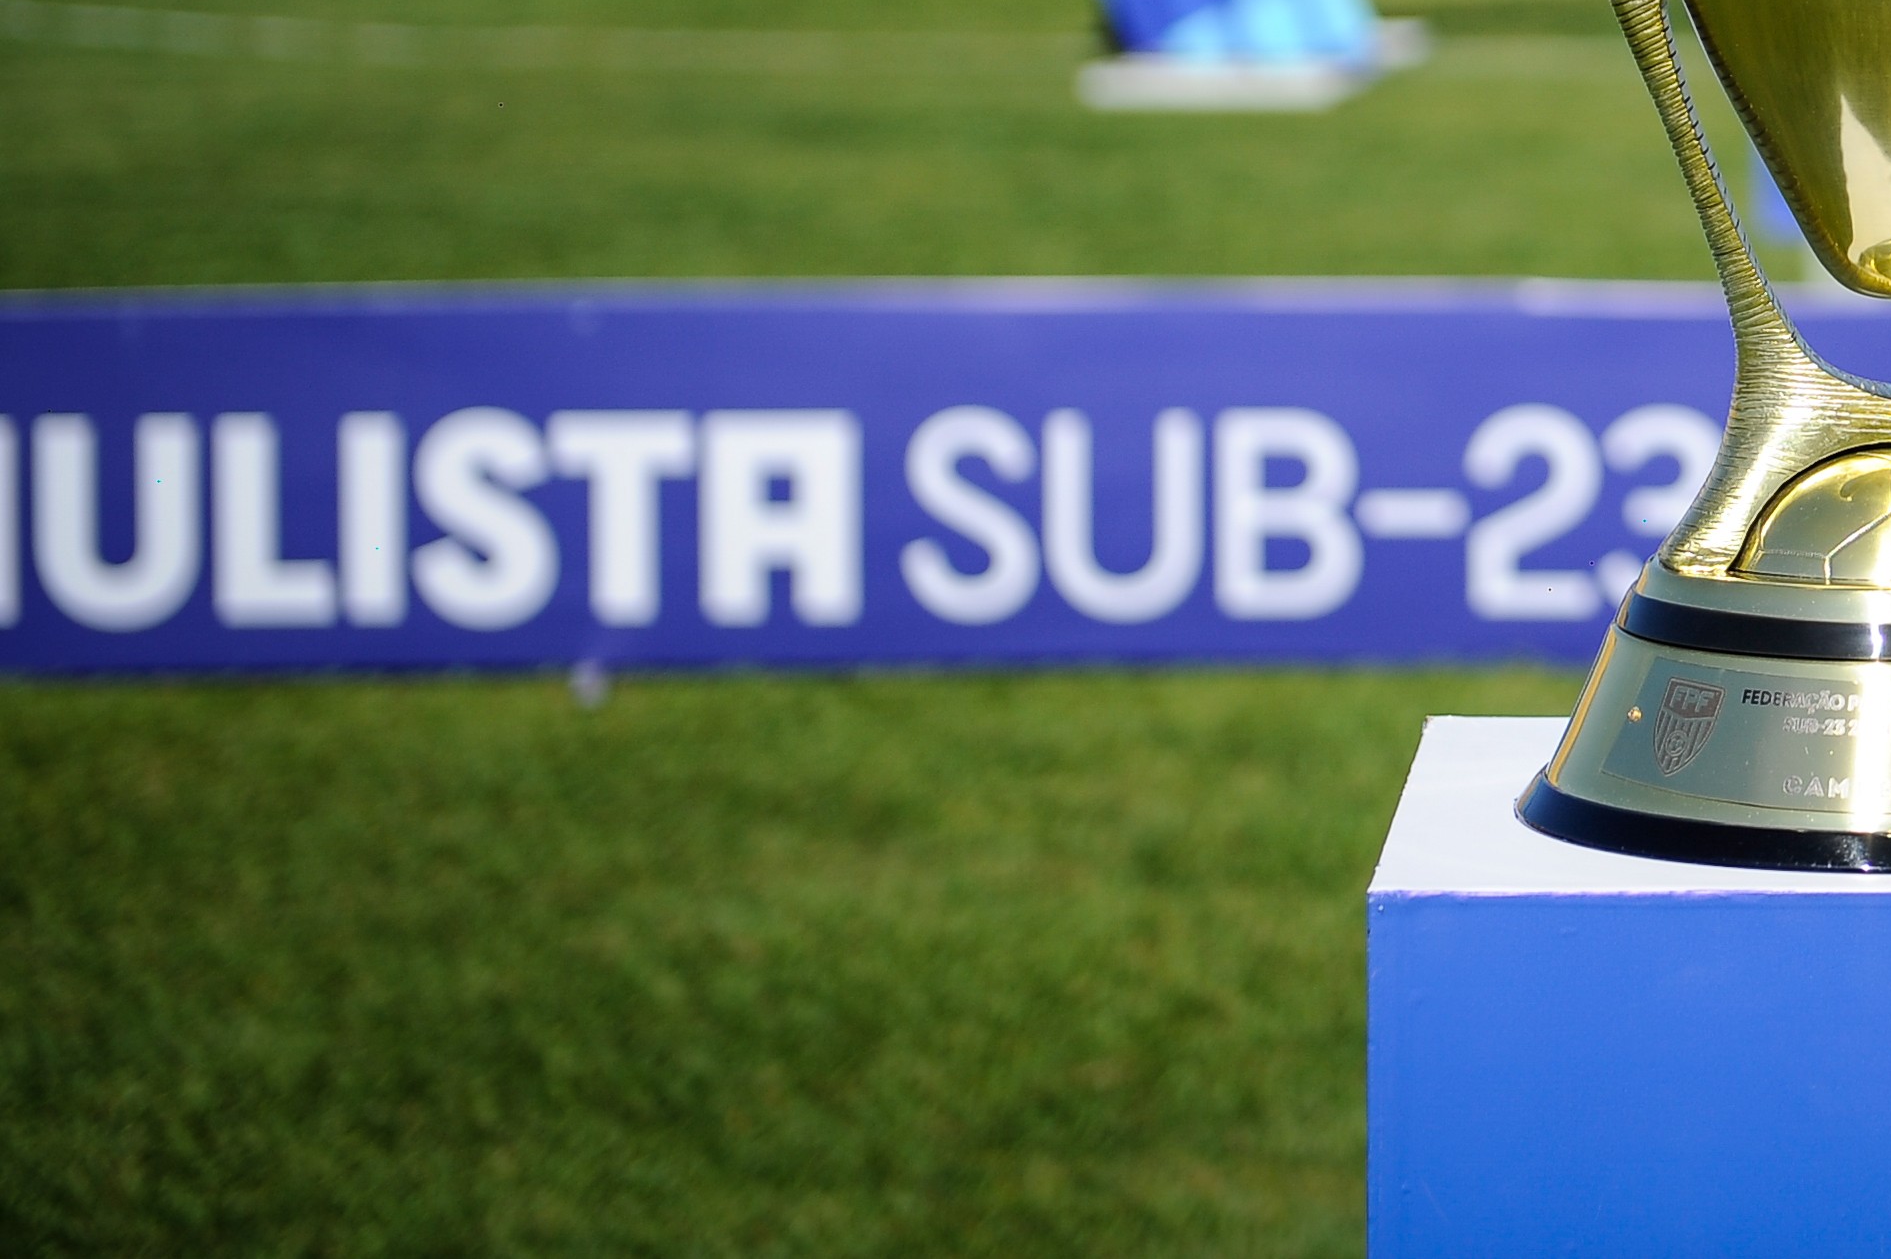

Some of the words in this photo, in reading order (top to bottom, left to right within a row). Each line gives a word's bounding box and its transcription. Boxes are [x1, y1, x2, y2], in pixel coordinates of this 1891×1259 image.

[0, 406, 862, 632] ULISTA
[900, 403, 1722, 624] SUB-23
[1669, 685, 1714, 713] FPF
[1742, 689, 1845, 714] FEDERAÇÃO
